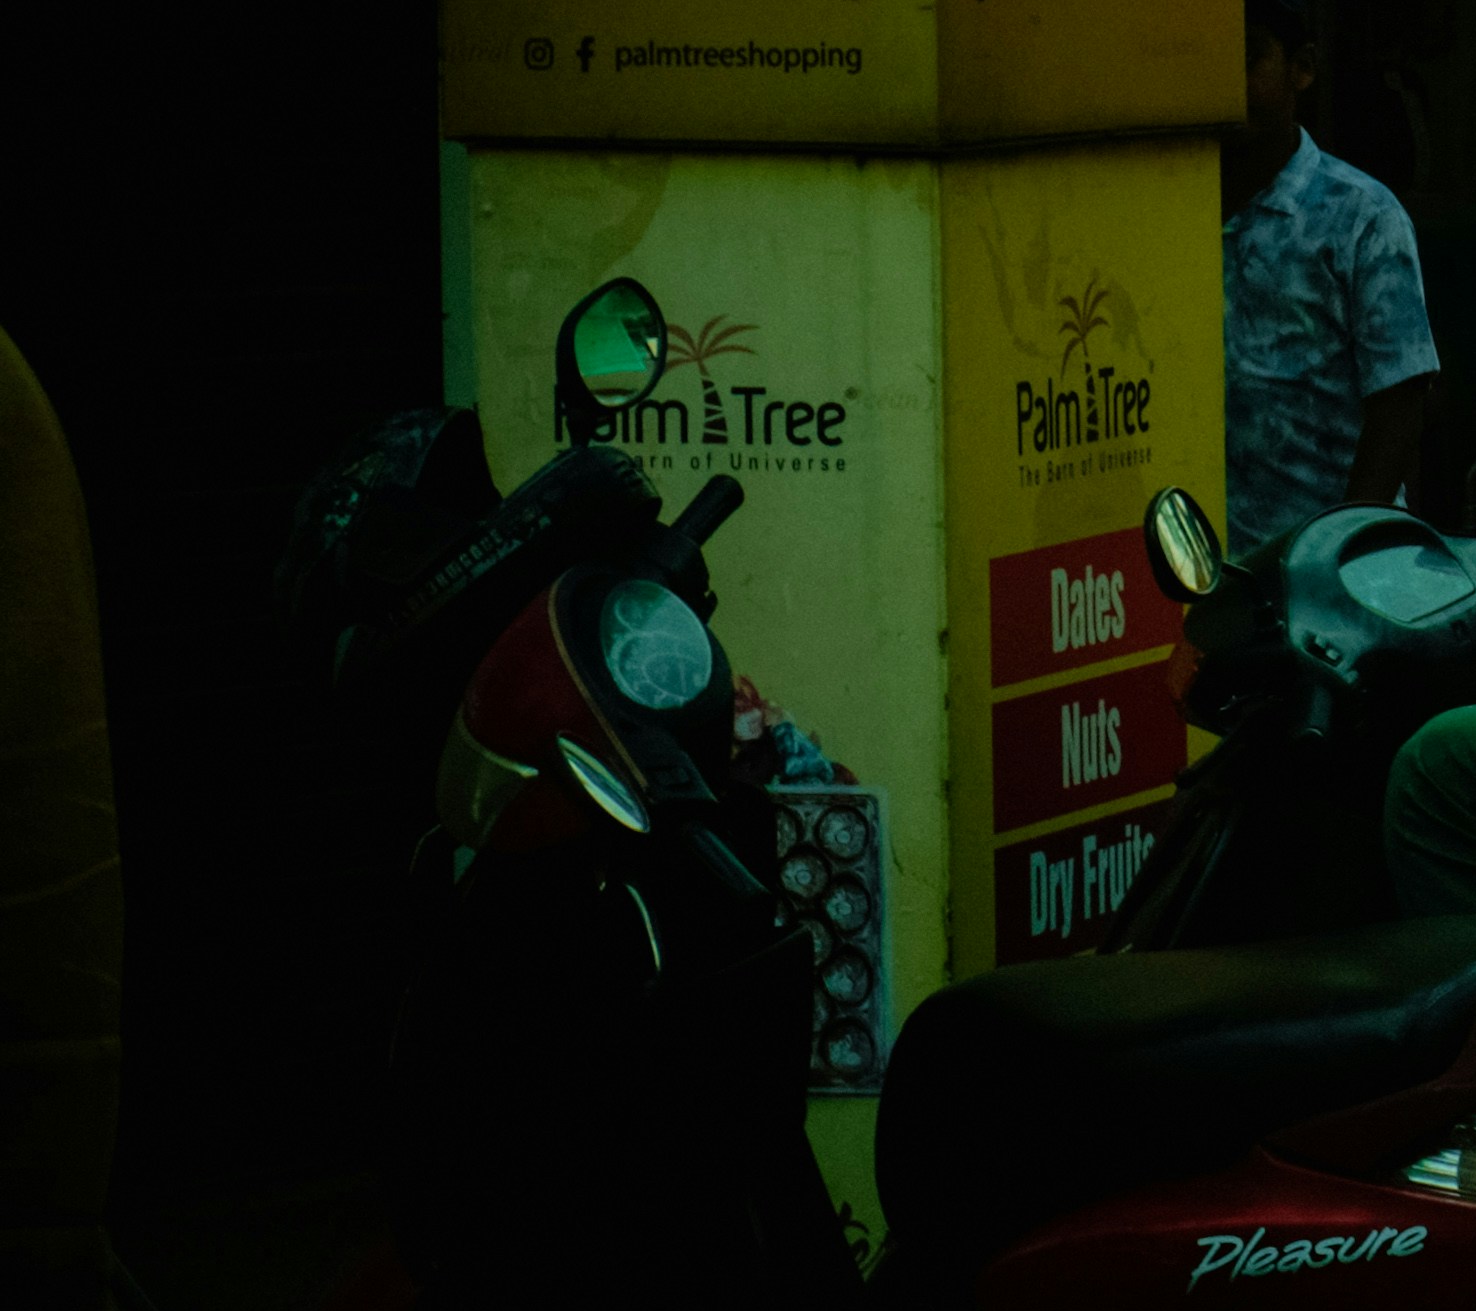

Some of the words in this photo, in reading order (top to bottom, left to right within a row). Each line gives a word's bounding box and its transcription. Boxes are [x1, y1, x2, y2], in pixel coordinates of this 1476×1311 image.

[614, 38, 864, 75] palmtreeshopping
[732, 386, 847, 446] Tree
[1016, 380, 1081, 456] Palm
[1098, 366, 1152, 442] Tree
[690, 451, 714, 471] of
[731, 451, 848, 472] Universe
[1018, 464, 1041, 487] The
[1046, 460, 1076, 485] Barn
[1097, 447, 1154, 476] Universe
[1050, 563, 1127, 655] Dates
[1060, 699, 1122, 791] Nuts
[1029, 849, 1076, 940] Dry
[1186, 1224, 1428, 1294] Pleasure
